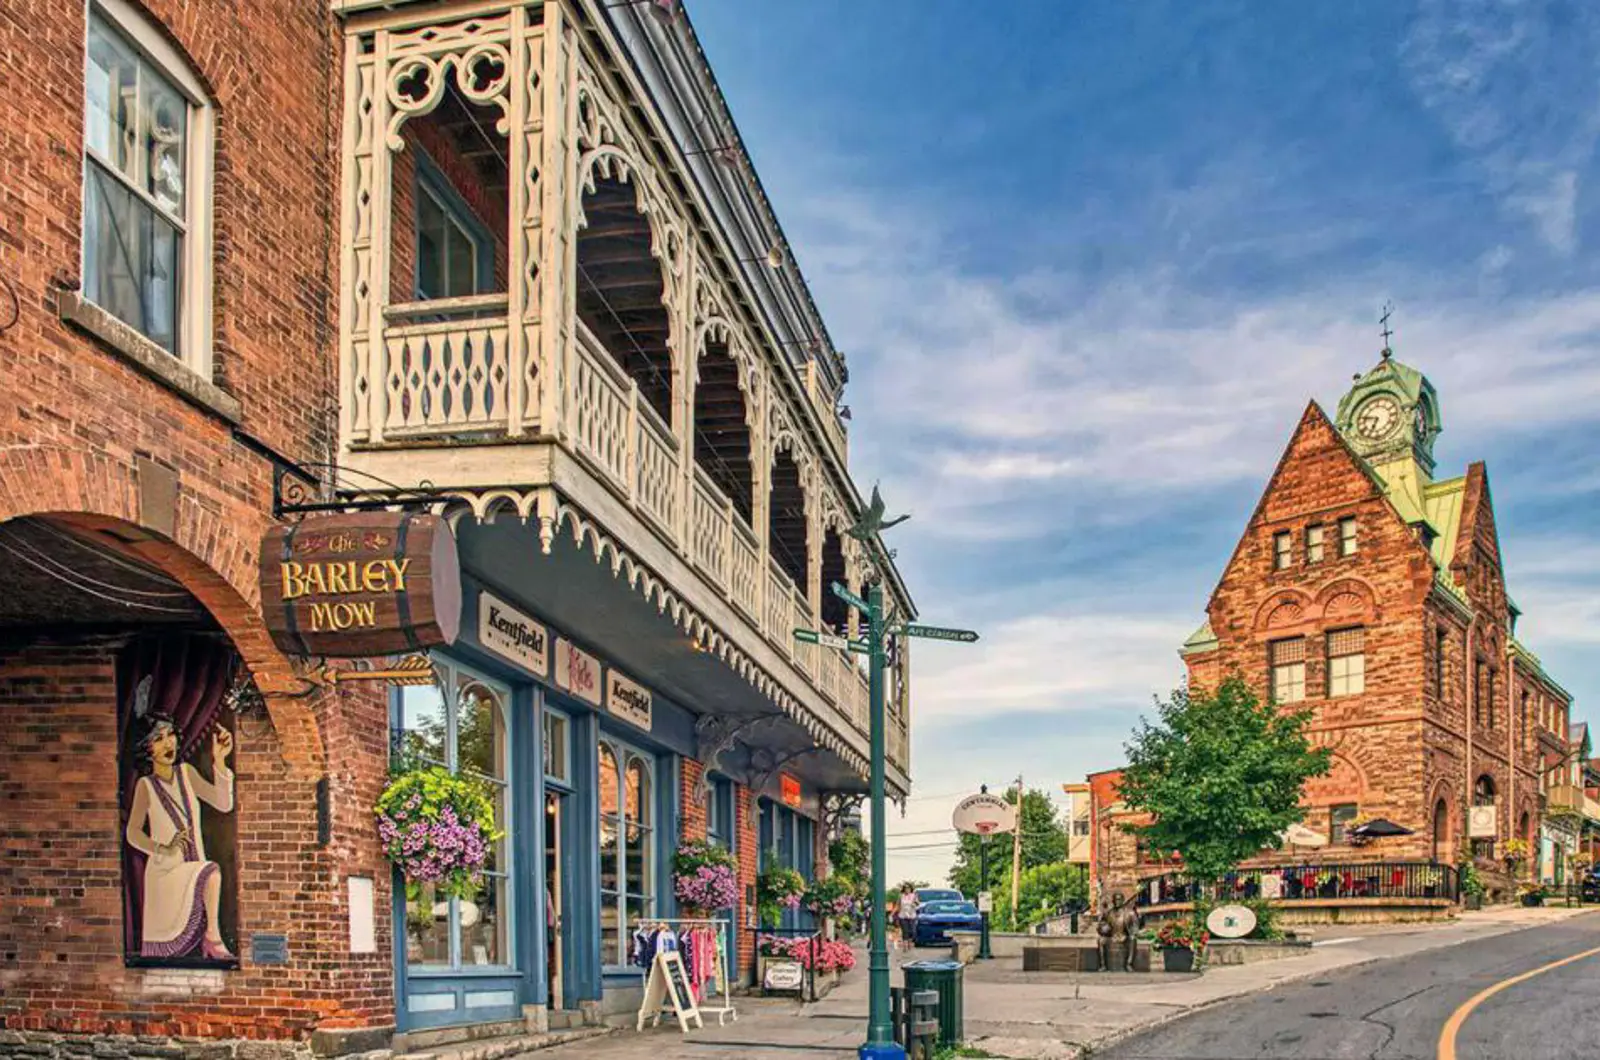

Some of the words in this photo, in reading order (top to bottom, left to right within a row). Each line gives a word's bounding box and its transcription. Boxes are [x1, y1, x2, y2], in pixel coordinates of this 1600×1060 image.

[280, 558, 411, 599] BARLEY
[310, 601, 376, 633] MOW
[488, 605, 544, 654] Kentfield
[612, 679, 649, 714] Kentfield
